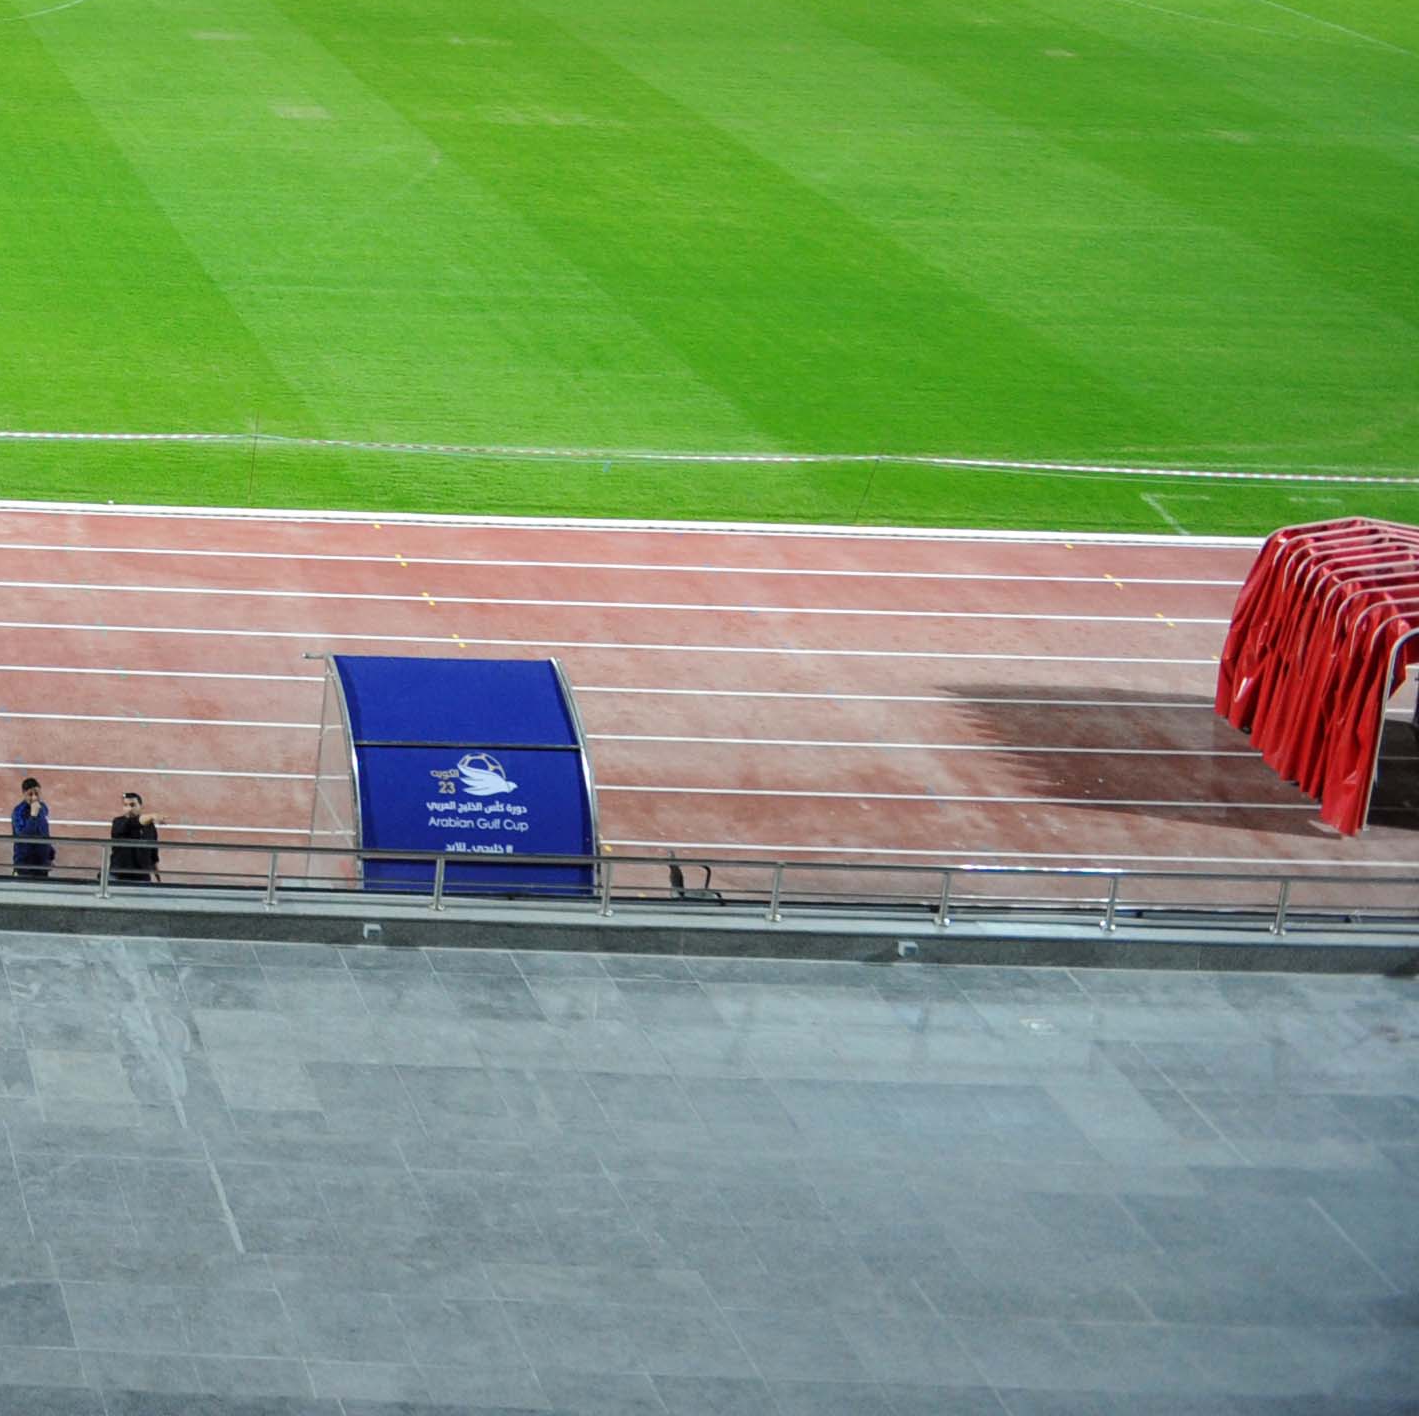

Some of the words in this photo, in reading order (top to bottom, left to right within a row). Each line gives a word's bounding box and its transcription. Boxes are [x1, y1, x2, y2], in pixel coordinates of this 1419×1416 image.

[438, 781, 456, 794] 23
[428, 816, 475, 829] Arabian
[476, 817, 501, 830] Gulf
[503, 819, 529, 832] Cup
